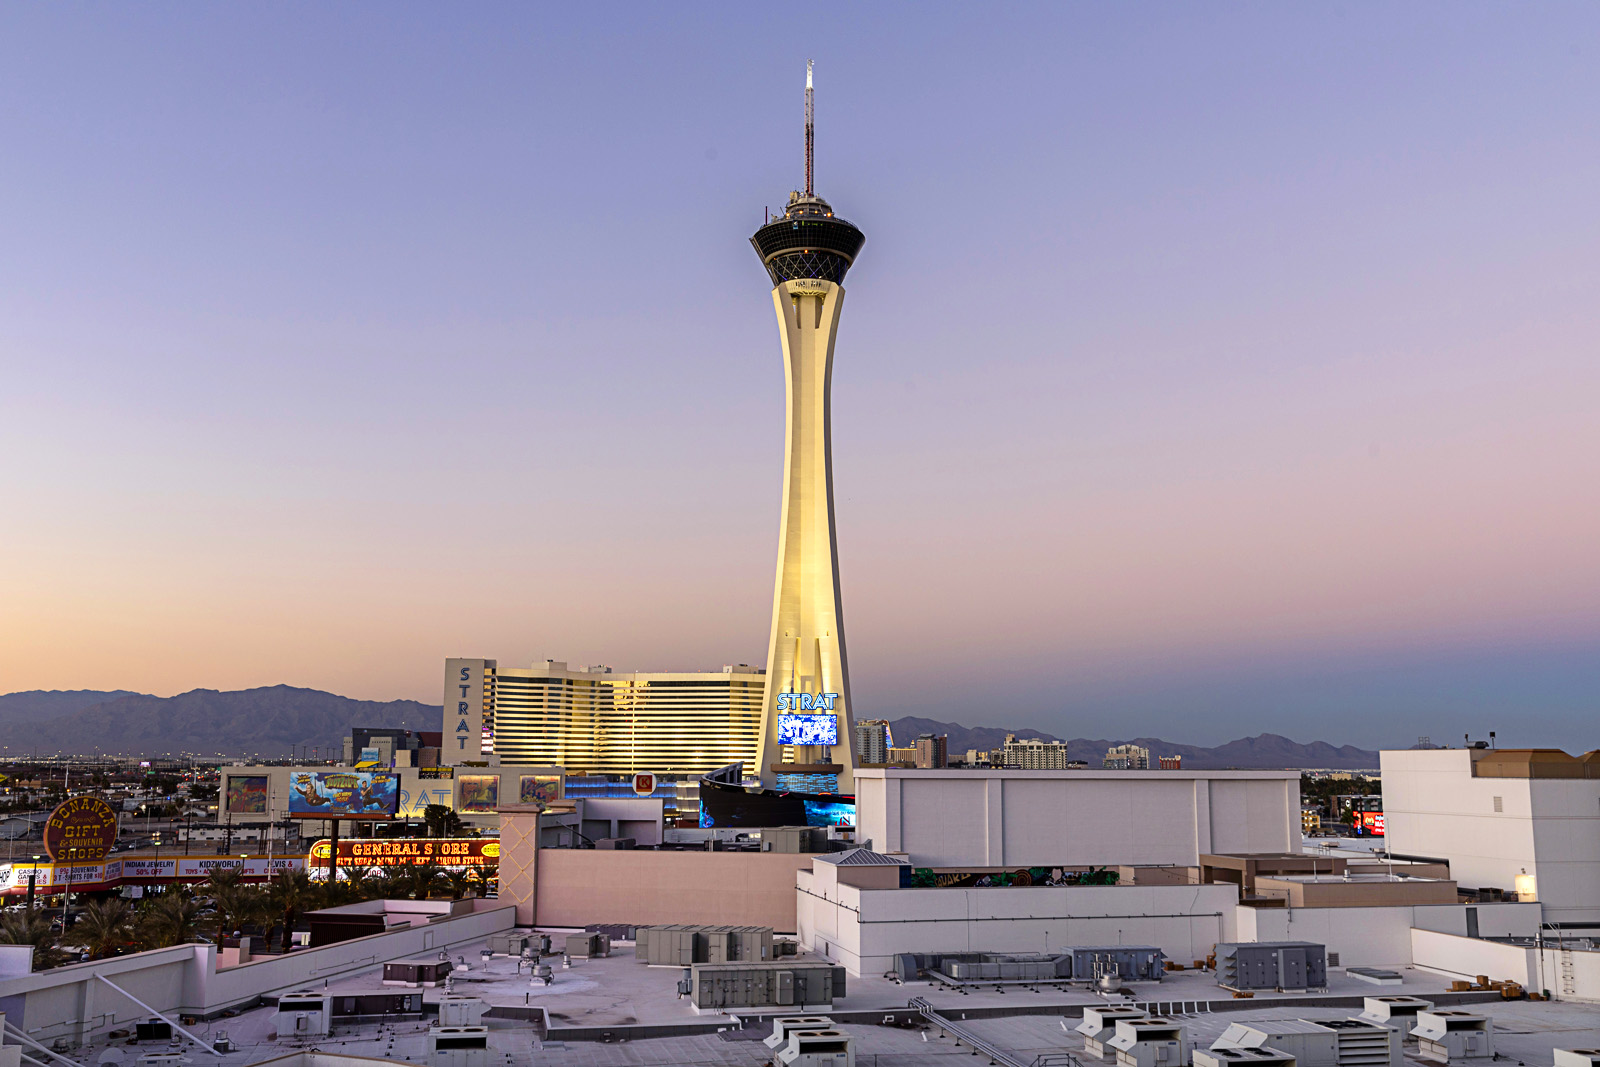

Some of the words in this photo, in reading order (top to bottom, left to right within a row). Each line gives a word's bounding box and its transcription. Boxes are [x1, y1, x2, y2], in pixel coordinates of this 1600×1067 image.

[777, 692, 838, 710] STRAT
[456, 667, 471, 750] STRAT
[51, 798, 115, 828] BONANZA
[64, 825, 101, 837] GIFT
[59, 839, 68, 847] &
[69, 838, 104, 847] SOUVENIR
[58, 848, 104, 859] SHOPS
[352, 843, 421, 856] GENERAL
[424, 842, 470, 855] STORE
[199, 860, 241, 868] KIDZWORLD
[287, 860, 293, 868] &
[354, 857, 372, 865] SHOP
[463, 856, 484, 864] STORE
[71, 865, 98, 873] SOUVENIRS
[136, 868, 149, 876] 50%
[150, 868, 163, 876] OFF
